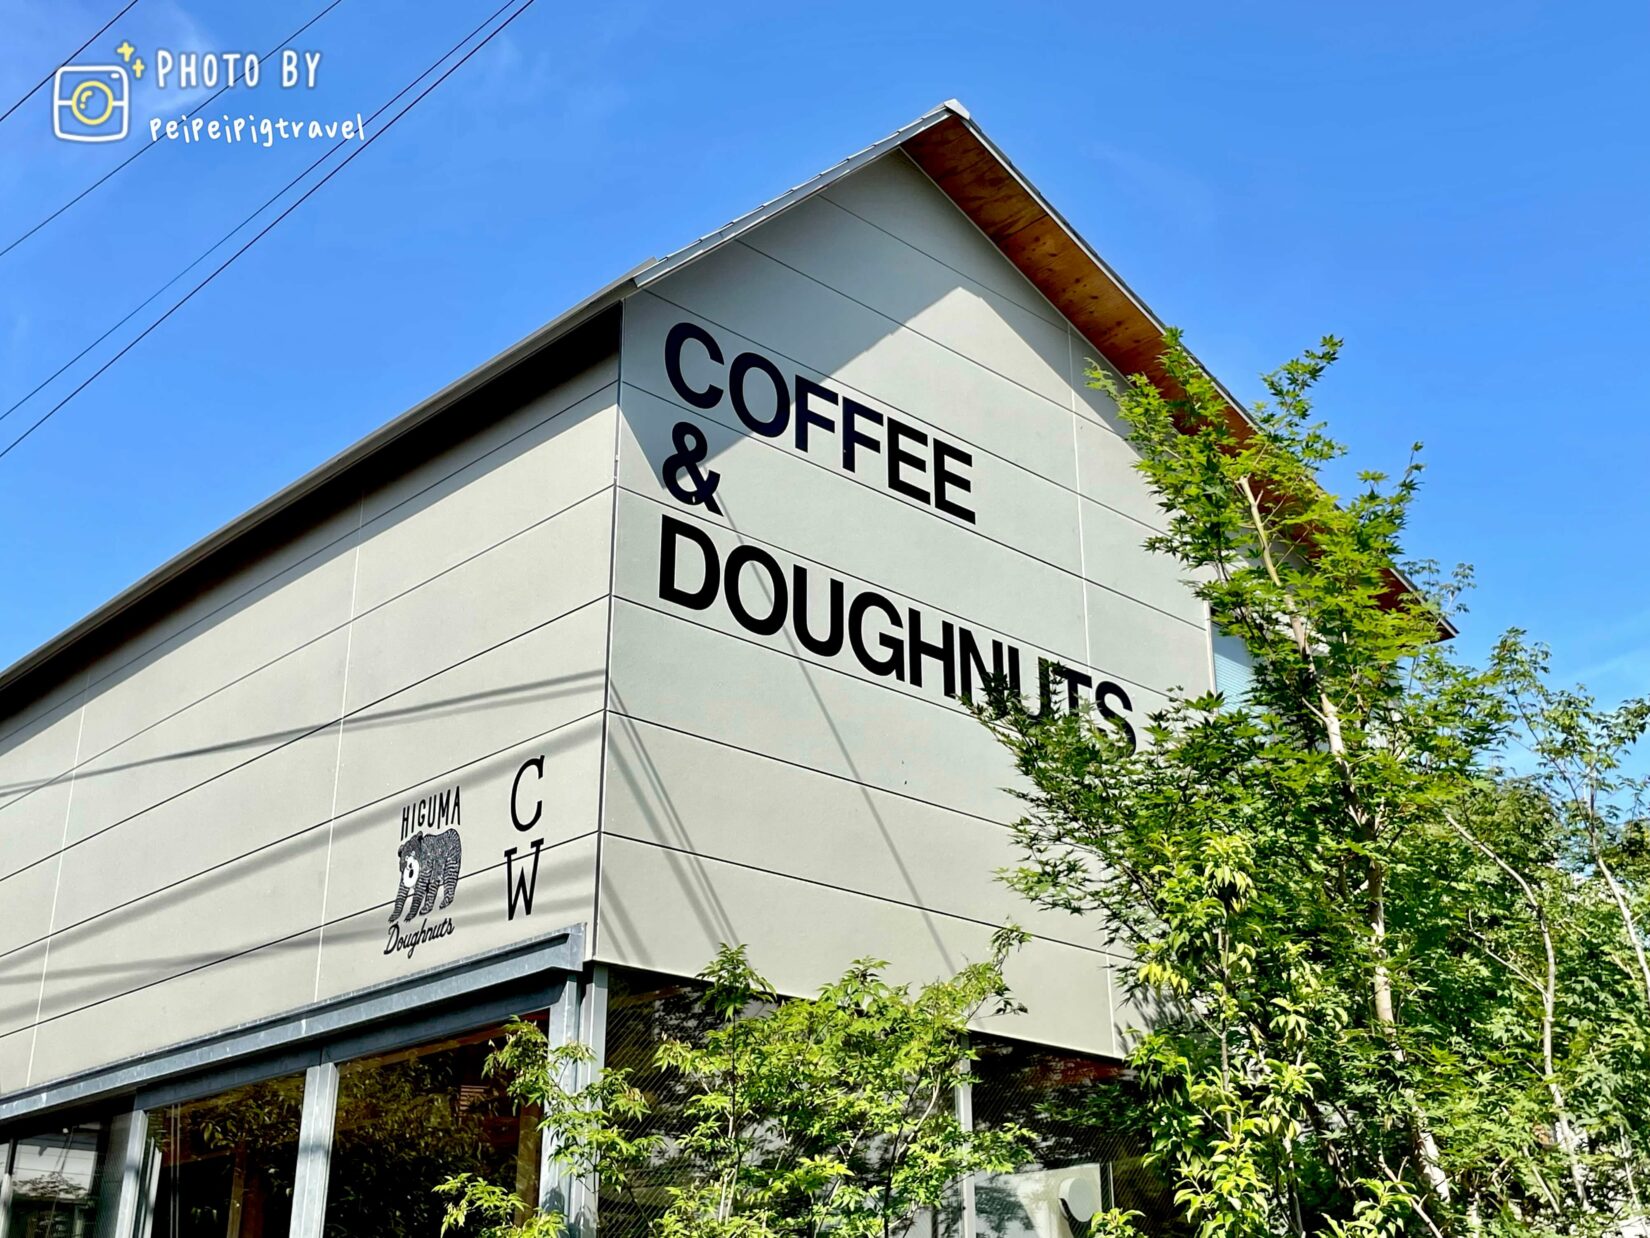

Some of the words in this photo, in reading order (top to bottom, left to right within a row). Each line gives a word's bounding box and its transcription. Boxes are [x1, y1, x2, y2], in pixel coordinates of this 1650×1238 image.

[664, 321, 977, 526] COFFEE
[661, 421, 724, 517] &
[658, 513, 1138, 757] DOUGHNUTS
[400, 785, 461, 842] HIGUMA
[510, 754, 545, 832] C
[503, 837, 545, 921] W
[383, 917, 456, 960] Doughnuts
